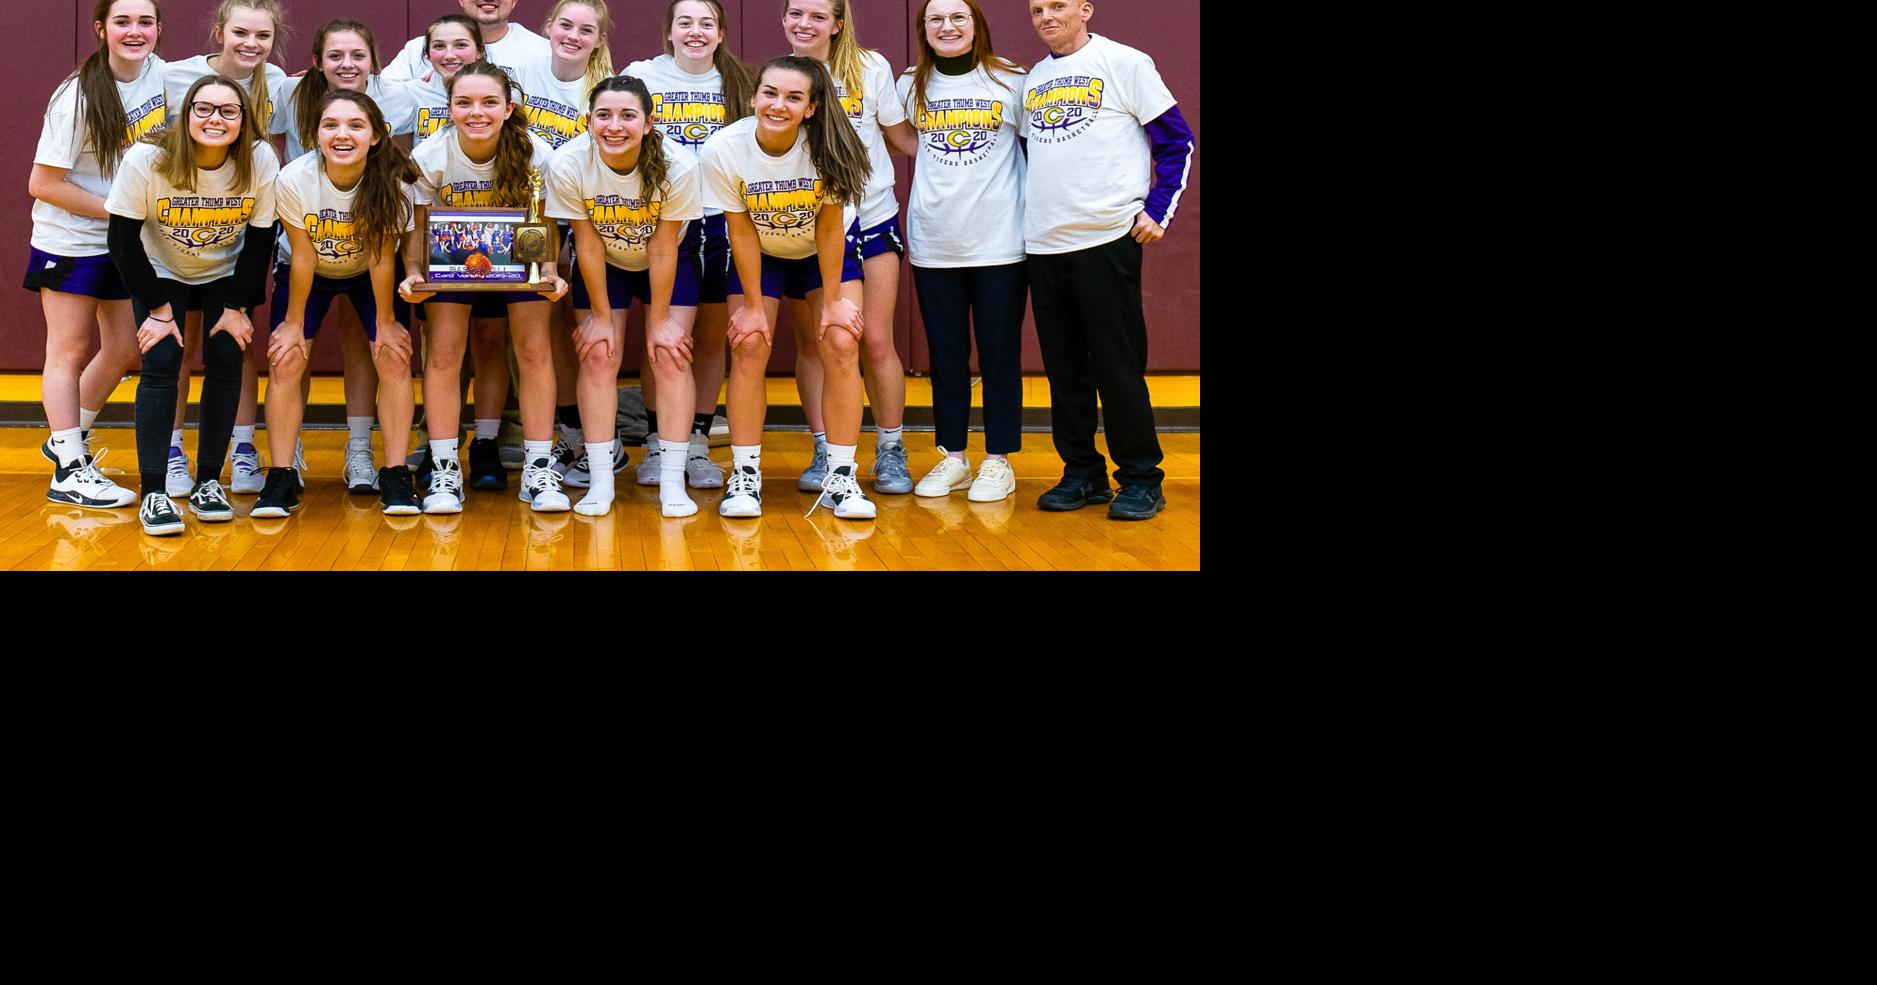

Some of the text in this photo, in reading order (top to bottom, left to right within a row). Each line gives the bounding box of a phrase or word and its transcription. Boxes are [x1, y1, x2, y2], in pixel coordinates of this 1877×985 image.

[1074, 76, 1090, 86] WEST
[664, 92, 688, 102] GREATER
[690, 92, 710, 102] THUMB
[1024, 77, 1104, 113] CHAMPIONS
[928, 99, 991, 110] GREATER THUMB WEST
[916, 100, 1003, 134] CHAMPIONS
[1032, 107, 1082, 124] 20 C 20
[667, 125, 681, 135] 20
[684, 124, 709, 140] C
[931, 130, 987, 148] 20 C 20
[933, 154, 958, 167] TIGERS
[453, 181, 477, 191] GREATER
[748, 178, 812, 194] GREATER THUMB WEST
[172, 196, 242, 207] GREATER THUMB WEST
[596, 194, 620, 205] GREATER
[157, 197, 255, 228] CHAMPIONS
[754, 211, 815, 226] 20 C 20
[172, 228, 189, 238] 20
[191, 227, 217, 243] C
[219, 226, 234, 235] 20
[599, 225, 615, 233] 20
[320, 240, 333, 251] 20
